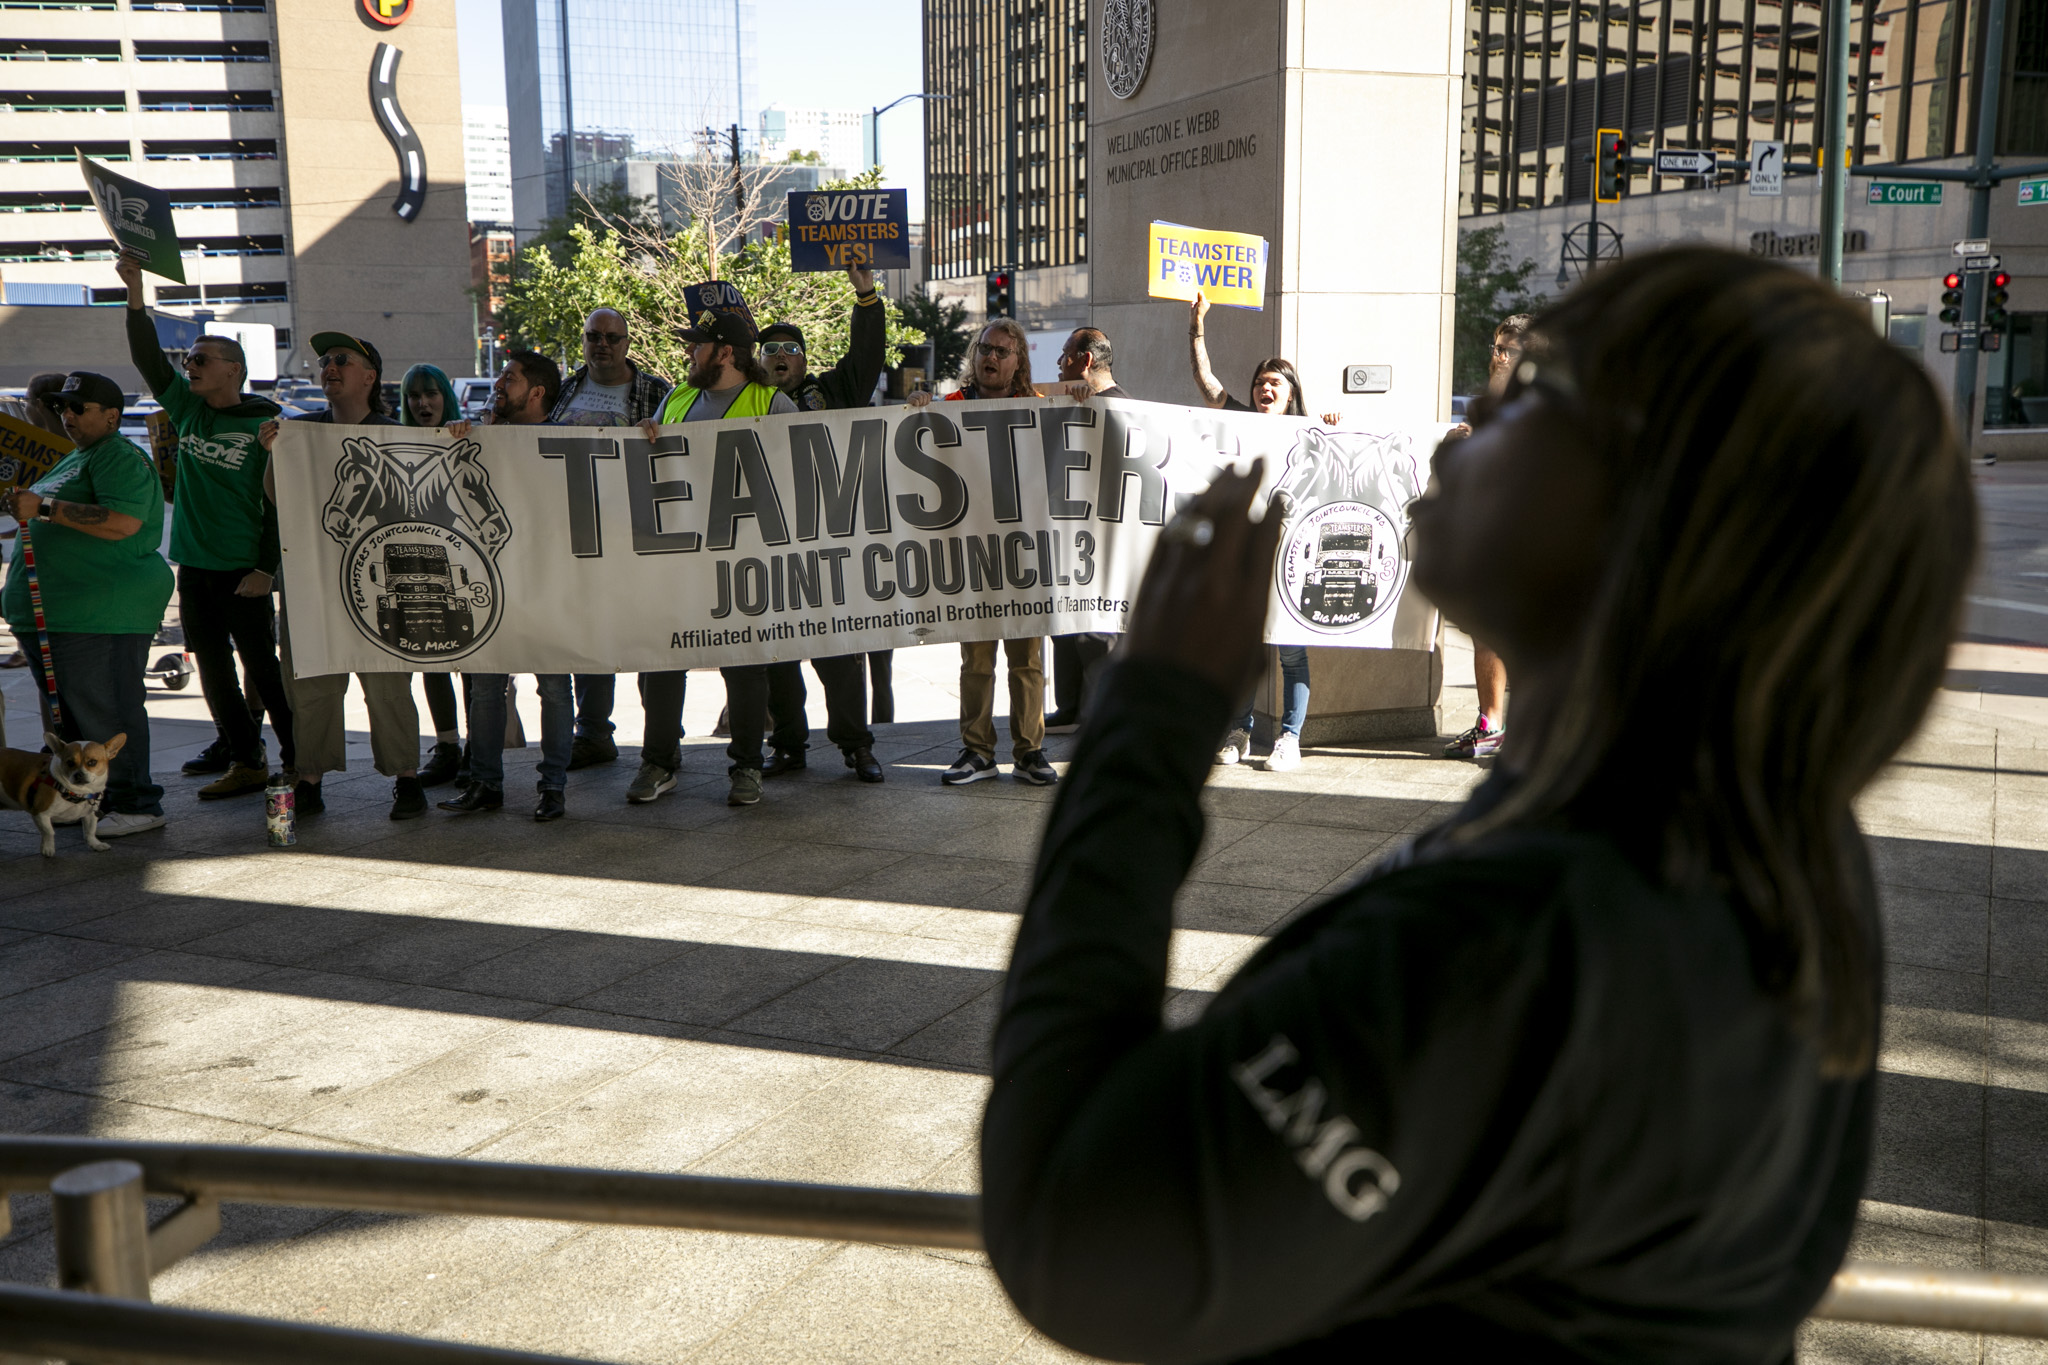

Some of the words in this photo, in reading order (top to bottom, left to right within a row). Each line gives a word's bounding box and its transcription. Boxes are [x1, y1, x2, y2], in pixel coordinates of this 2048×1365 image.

[1118, 78, 1131, 93] SEAL
[1107, 123, 1172, 156] WELLINGTON
[1174, 120, 1184, 140] E.
[1186, 109, 1220, 136] WEBB
[1107, 160, 1158, 186] MUNICIPAL
[1160, 148, 1199, 175] OFFICE
[1201, 134, 1257, 167] BUILDING
[1663, 156, 1679, 167] ONE
[1681, 156, 1698, 167] WAY
[1754, 174, 1778, 183] ONLY
[1887, 185, 1925, 202] Court
[823, 193, 890, 221] VOTE
[114, 210, 156, 241] ORGANIZED
[798, 222, 899, 242] TEAMSTERS
[823, 242, 874, 266] YES!
[1156, 236, 1257, 264] TEAMSTER
[1750, 230, 1867, 257] Sheran
[1161, 258, 1253, 289] PWER
[215, 459, 240, 471] Happen
[395, 545, 435, 556] TEAMSTERS
[1287, 527, 1307, 588] TEAMSTE
[353, 547, 370, 612] TEAMSTERS
[710, 547, 850, 619] JOINT
[862, 529, 1070, 601] COUNCIL
[1074, 529, 1095, 585] 3
[1380, 556, 1396, 581] 3
[469, 582, 491, 608] 3
[670, 626, 751, 649] Affiliated
[757, 622, 795, 643] with
[798, 619, 827, 638] the
[831, 605, 942, 634] International
[946, 596, 1054, 622] Brotherhood
[1064, 595, 1129, 613] Teamsters
[1312, 611, 1330, 623] BIG
[1331, 612, 1361, 624] MACK
[399, 637, 421, 651] BIG
[425, 639, 460, 651] MACK
[1230, 1035, 1400, 1223] LMG
